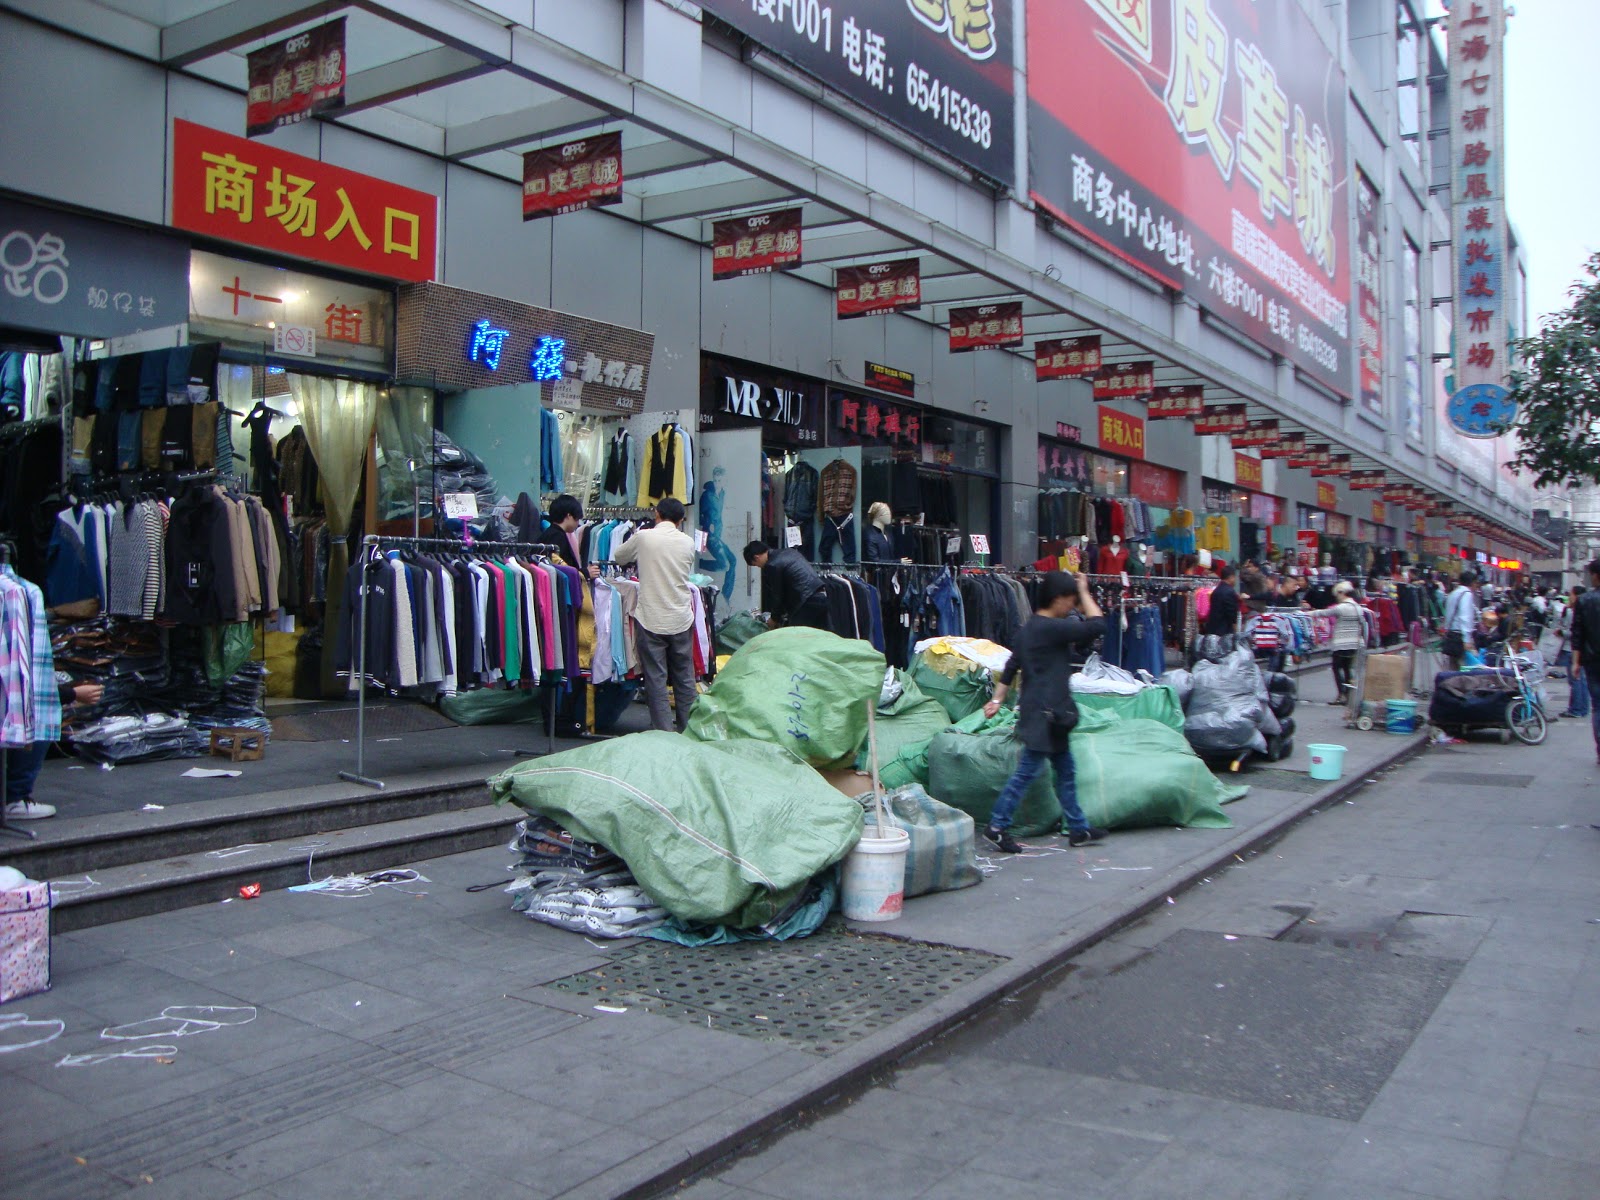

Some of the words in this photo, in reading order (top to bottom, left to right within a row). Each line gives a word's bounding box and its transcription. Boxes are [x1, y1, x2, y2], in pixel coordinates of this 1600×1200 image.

[906, 62, 991, 149] 65415338
[548, 157, 618, 196] 皮草城
[1459, 2, 1496, 370] 上海七浦路服装批发市场
[201, 151, 420, 261] 商场入口
[735, 230, 799, 259] 皮草城
[617, 397, 633, 408] A328
[700, 413, 713, 424] A314
[1102, 415, 1142, 449] 商场入口
